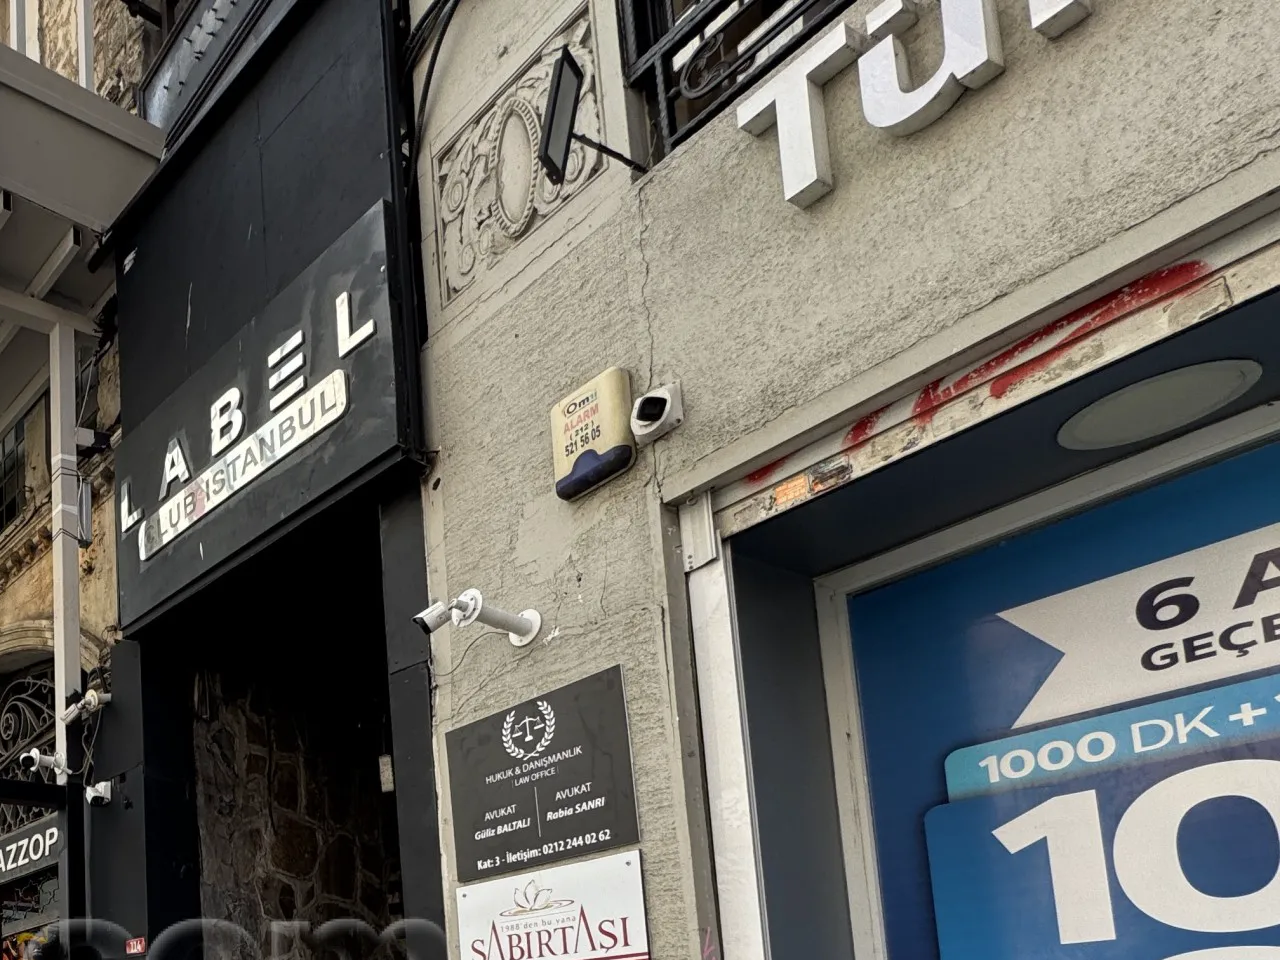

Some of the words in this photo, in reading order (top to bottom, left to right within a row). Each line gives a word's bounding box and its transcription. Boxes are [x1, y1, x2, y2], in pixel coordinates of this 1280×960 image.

[564, 403, 599, 434] ALARM
[565, 439, 578, 457] 521
[580, 433, 590, 447] 56
[591, 426, 601, 441] 05
[144, 491, 197, 545] CLUB
[1135, 576, 1200, 631] 6
[978, 731, 1116, 784] 1000
[1131, 705, 1221, 754] DK
[485, 767, 515, 785] HUKUK
[522, 745, 583, 773] DANIŞMANLIK
[514, 775, 530, 787] LAW
[531, 767, 557, 782] OFFICE
[555, 782, 592, 802] AVUKAT
[484, 804, 517, 822] AVUKAT
[546, 808, 574, 822] Rabia
[574, 796, 606, 814] SANRI
[474, 826, 496, 841] Güliz
[496, 817, 532, 835] BALTALI
[477, 858, 494, 871] Kat:
[495, 856, 501, 867] 3
[506, 848, 542, 864] İletişim:
[542, 842, 565, 856] 0212
[566, 837, 584, 851] 244
[584, 833, 597, 846] 02
[598, 829, 611, 842] 62
[500, 921, 539, 932] 1988'den
[541, 918, 553, 927] bu
[556, 915, 576, 927] yana
[128, 939, 143, 954] 114
